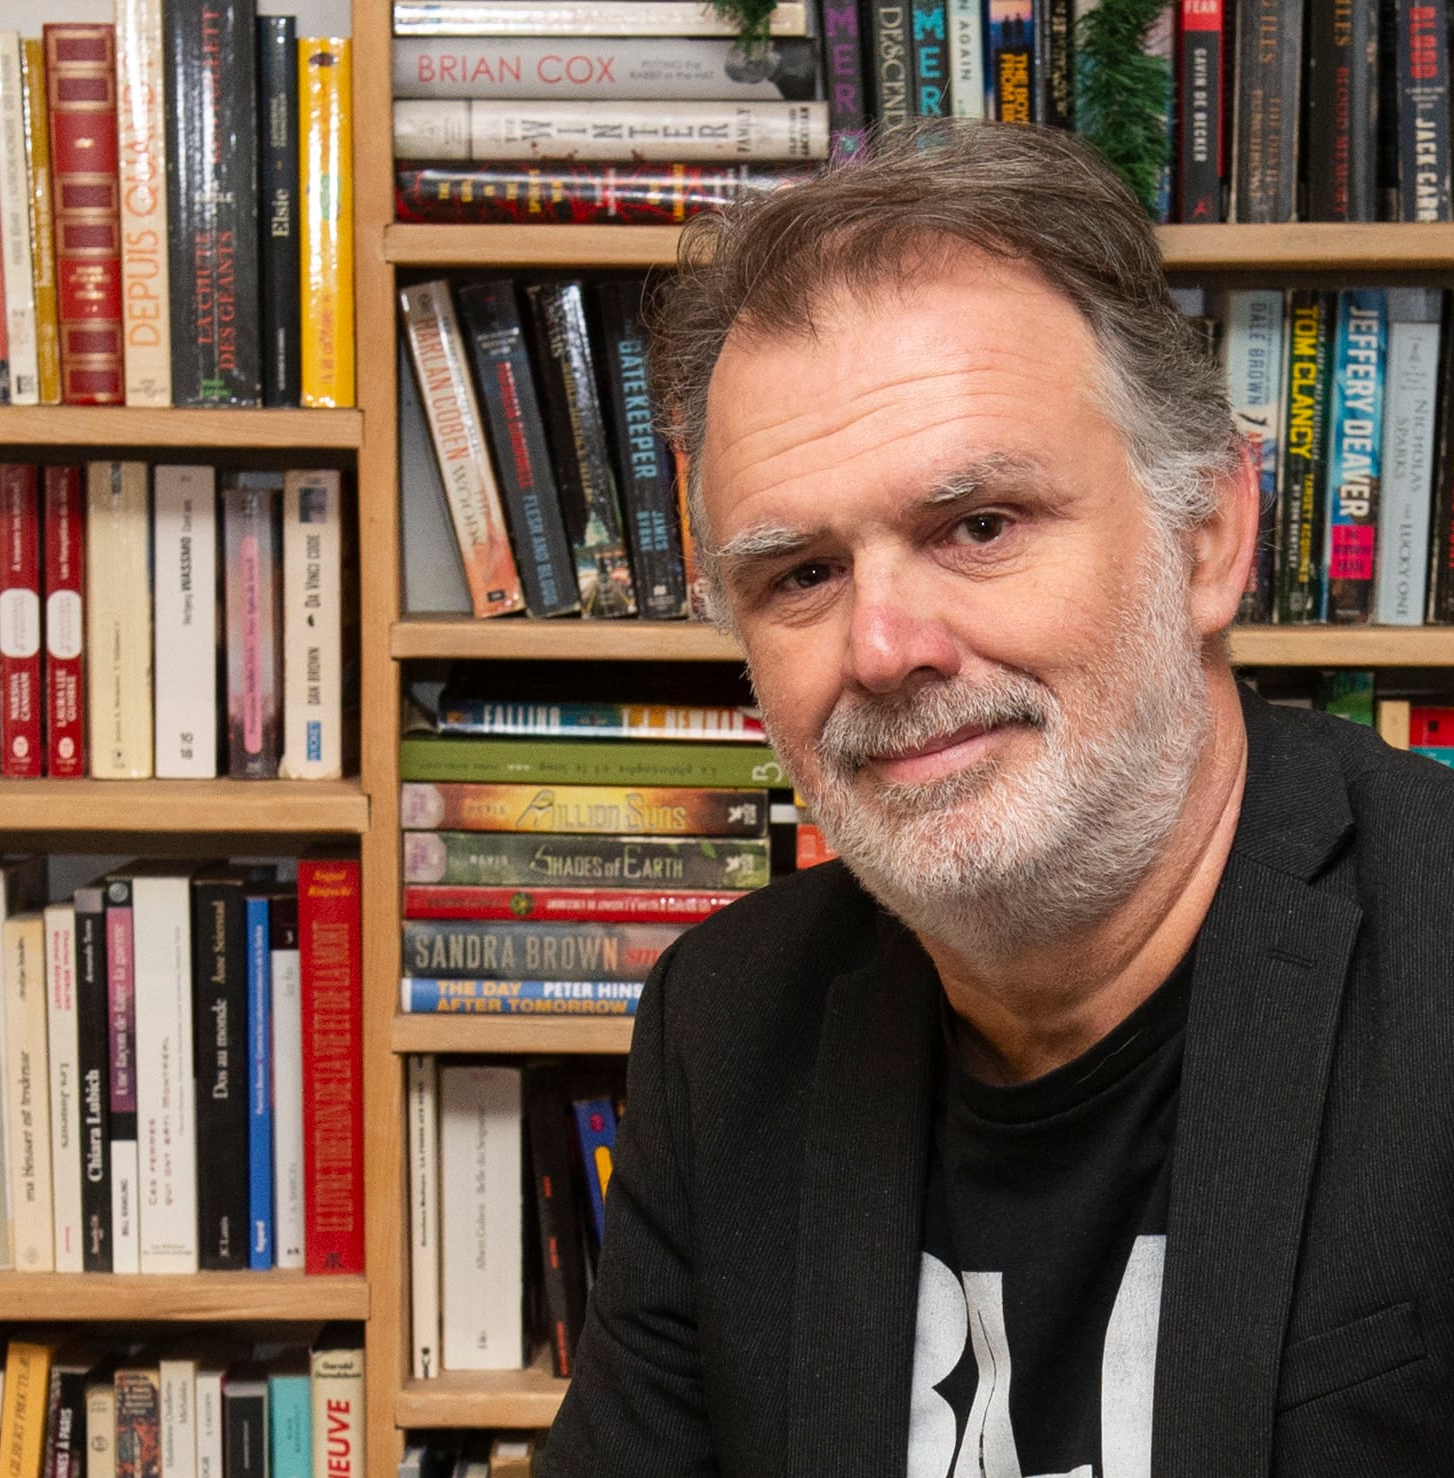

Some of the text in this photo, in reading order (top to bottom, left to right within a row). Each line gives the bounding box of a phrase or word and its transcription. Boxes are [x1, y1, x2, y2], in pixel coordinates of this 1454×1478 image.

[416, 55, 615, 84] BRIAN COX
[959, 20, 971, 80] AGAIN
[1415, 118, 1437, 165] JACK
[271, 188, 290, 237] Elsie
[126, 229, 161, 347] DEPUIS
[213, 231, 235, 370] DES GÉANTS
[197, 316, 212, 344] LA
[1248, 303, 1268, 406] DALE BROWN
[414, 319, 471, 461] HARLAN COBEN
[618, 340, 657, 479] GATEKEEPER
[1289, 305, 1318, 458] TOM CLANCY
[1338, 306, 1379, 516] JEFFERY DEAVER
[1410, 399, 1428, 492] NICHOLAS
[305, 647, 320, 682] BROWN
[415, 936, 618, 971] SANDRA BROWN
[437, 981, 522, 996] THE DAY
[543, 982, 642, 997] PETER HINS
[437, 997, 628, 1013] AFTER TOMORROW
[211, 998, 228, 1099] Dos au monde
[83, 1069, 103, 1182] Chiara Lubich
